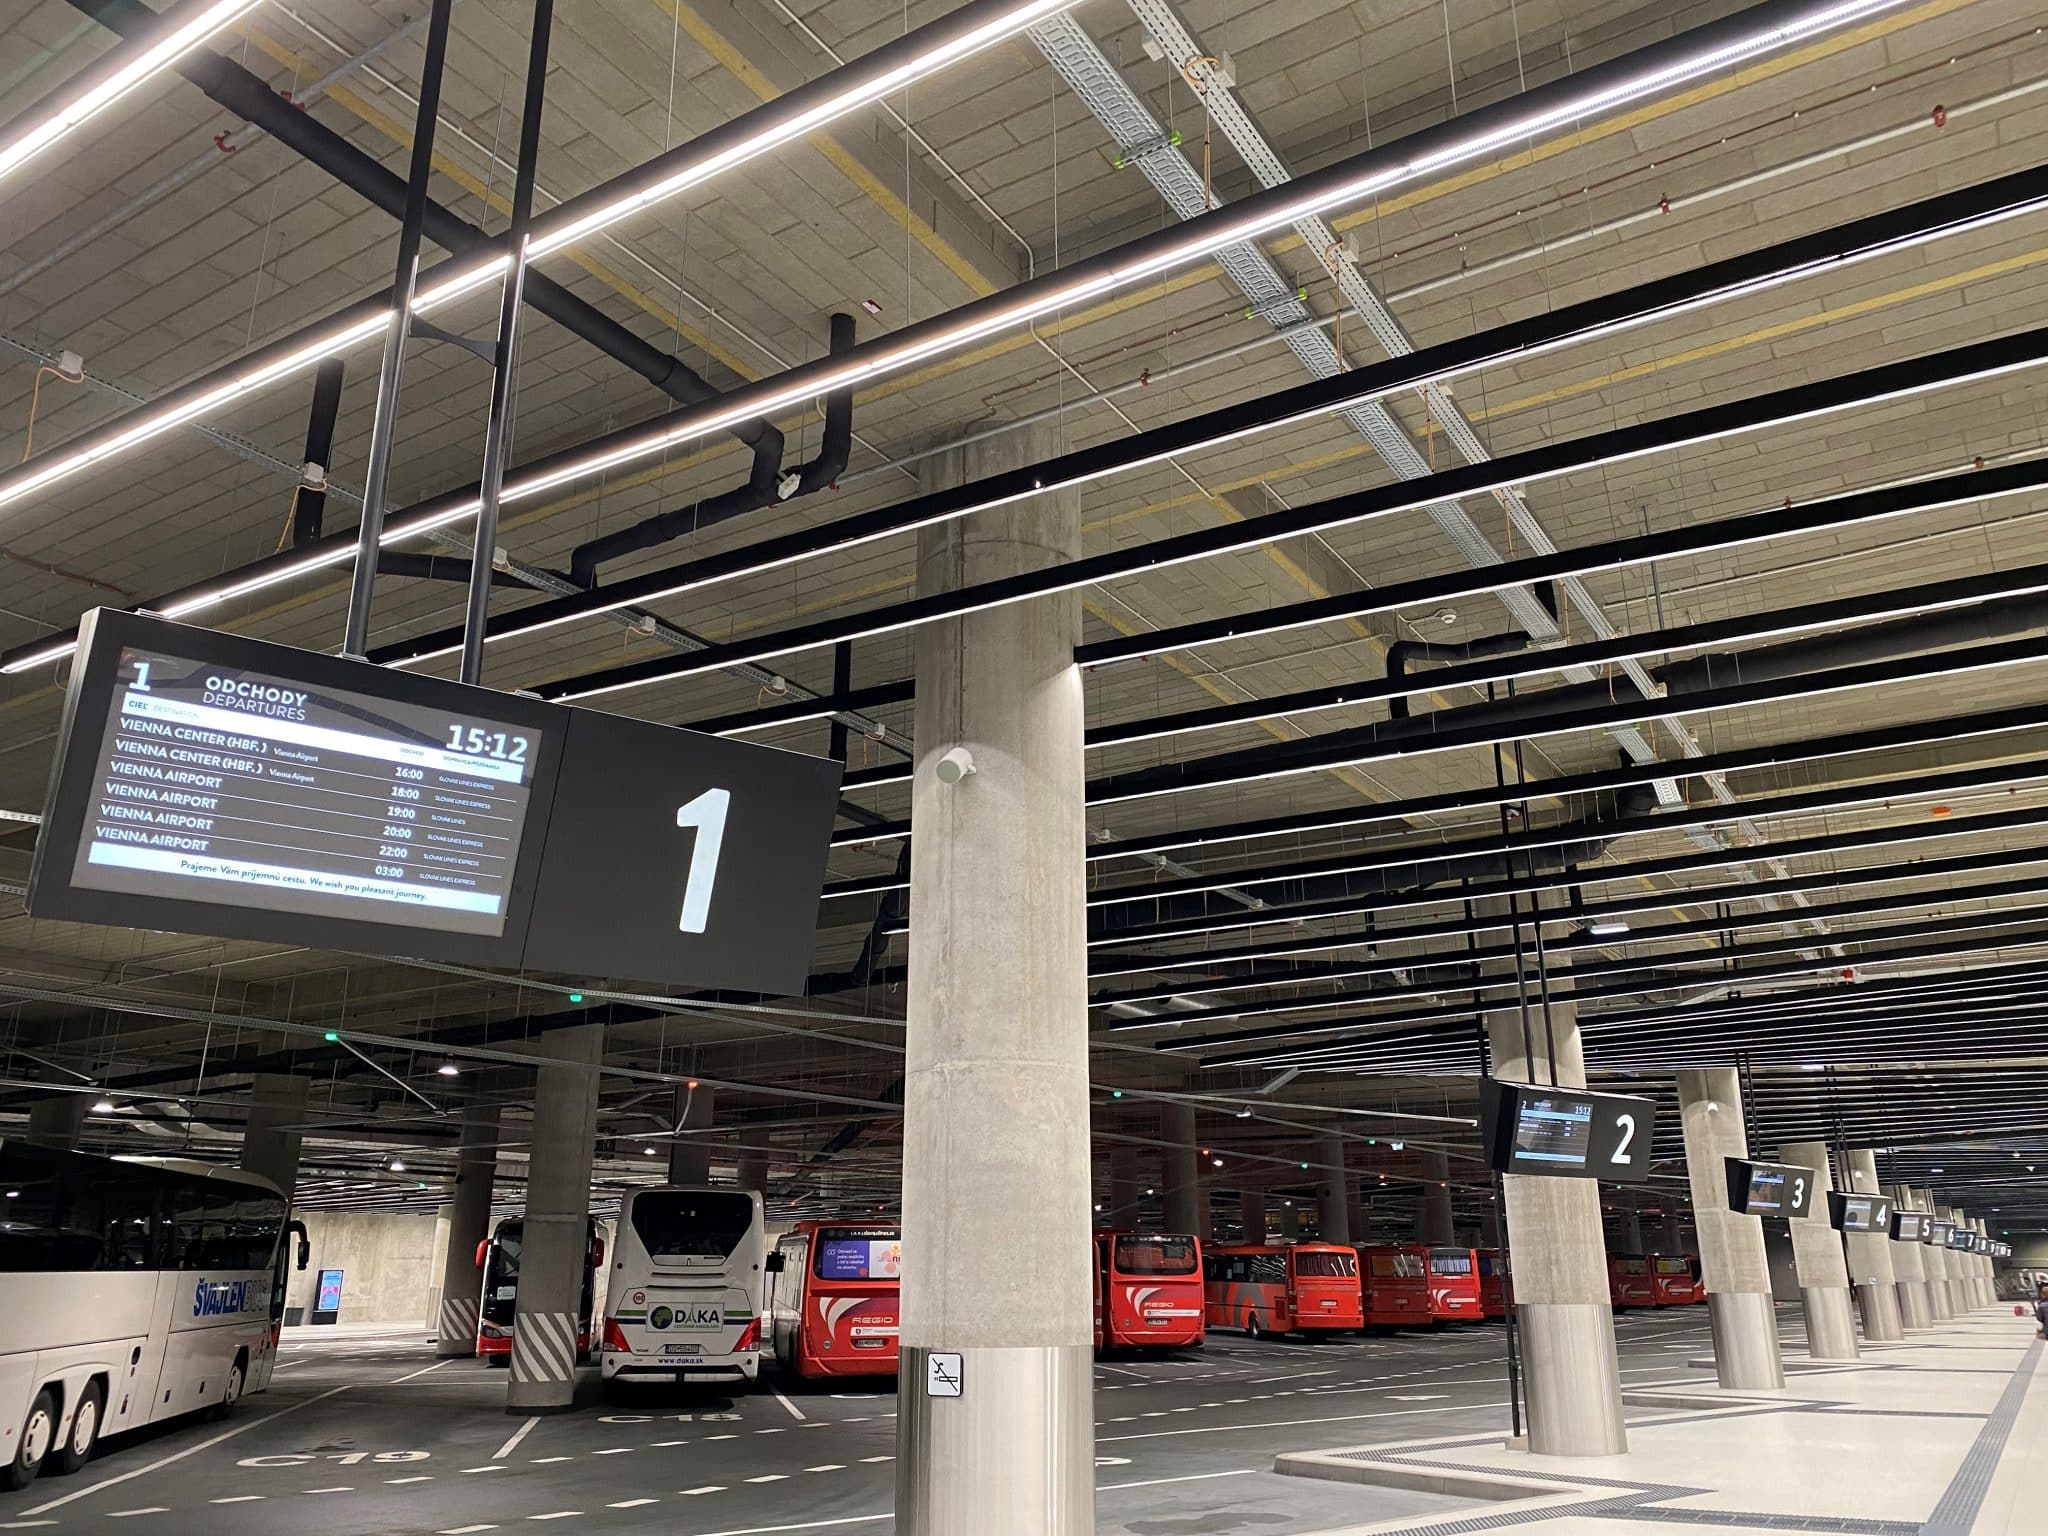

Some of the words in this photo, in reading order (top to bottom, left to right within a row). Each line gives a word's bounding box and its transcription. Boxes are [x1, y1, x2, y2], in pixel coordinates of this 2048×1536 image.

[129, 662, 151, 691] 1
[206, 676, 308, 707] ODCHODY
[202, 692, 306, 721] DEPARTURES
[120, 717, 172, 738] VIENNA
[174, 728, 225, 746] CENTER
[115, 739, 167, 759] VIENNA
[170, 749, 220, 767] CENTER
[274, 747, 296, 759] Vienna
[296, 751, 319, 763] Airport
[446, 724, 528, 763] 15:12
[111, 760, 163, 781] VIENNA
[164, 770, 223, 788] AIRPORT
[269, 768, 291, 779] Vienna
[292, 771, 315, 784] Airport
[395, 766, 424, 780] 16:00
[105, 782, 158, 802] VIENNA
[159, 791, 218, 810] AIRPORT
[391, 786, 419, 800] 18:00
[100, 804, 153, 823] VIENNA
[155, 813, 214, 831] AIRPORT
[387, 806, 416, 819] 19:00
[96, 825, 149, 844] VIENNA
[150, 834, 209, 852] AIRPORT
[383, 826, 412, 839] 20:00
[379, 845, 408, 859] 22:00
[677, 788, 730, 933] 1
[180, 860, 218, 873] Prajeme
[220, 863, 240, 875] Vám
[241, 867, 281, 881] príjemnú
[282, 874, 308, 885] cestu.
[309, 876, 324, 886] We
[325, 879, 343, 889] wish
[344, 883, 360, 893] you
[361, 882, 394, 897] pleasant
[395, 888, 428, 901] journey.
[375, 865, 403, 878] 03:00
[1610, 1114, 1635, 1165] 2
[1791, 1178, 1805, 1209] 3
[1876, 1204, 1887, 1227] 4
[1922, 1219, 1930, 1237] 5
[1948, 1228, 1954, 1243] 6
[1968, 1234, 1974, 1247] 7
[674, 1305, 719, 1324] DAKA
[852, 1316, 893, 1324] REGIO
[236, 1450, 431, 1467] C19
